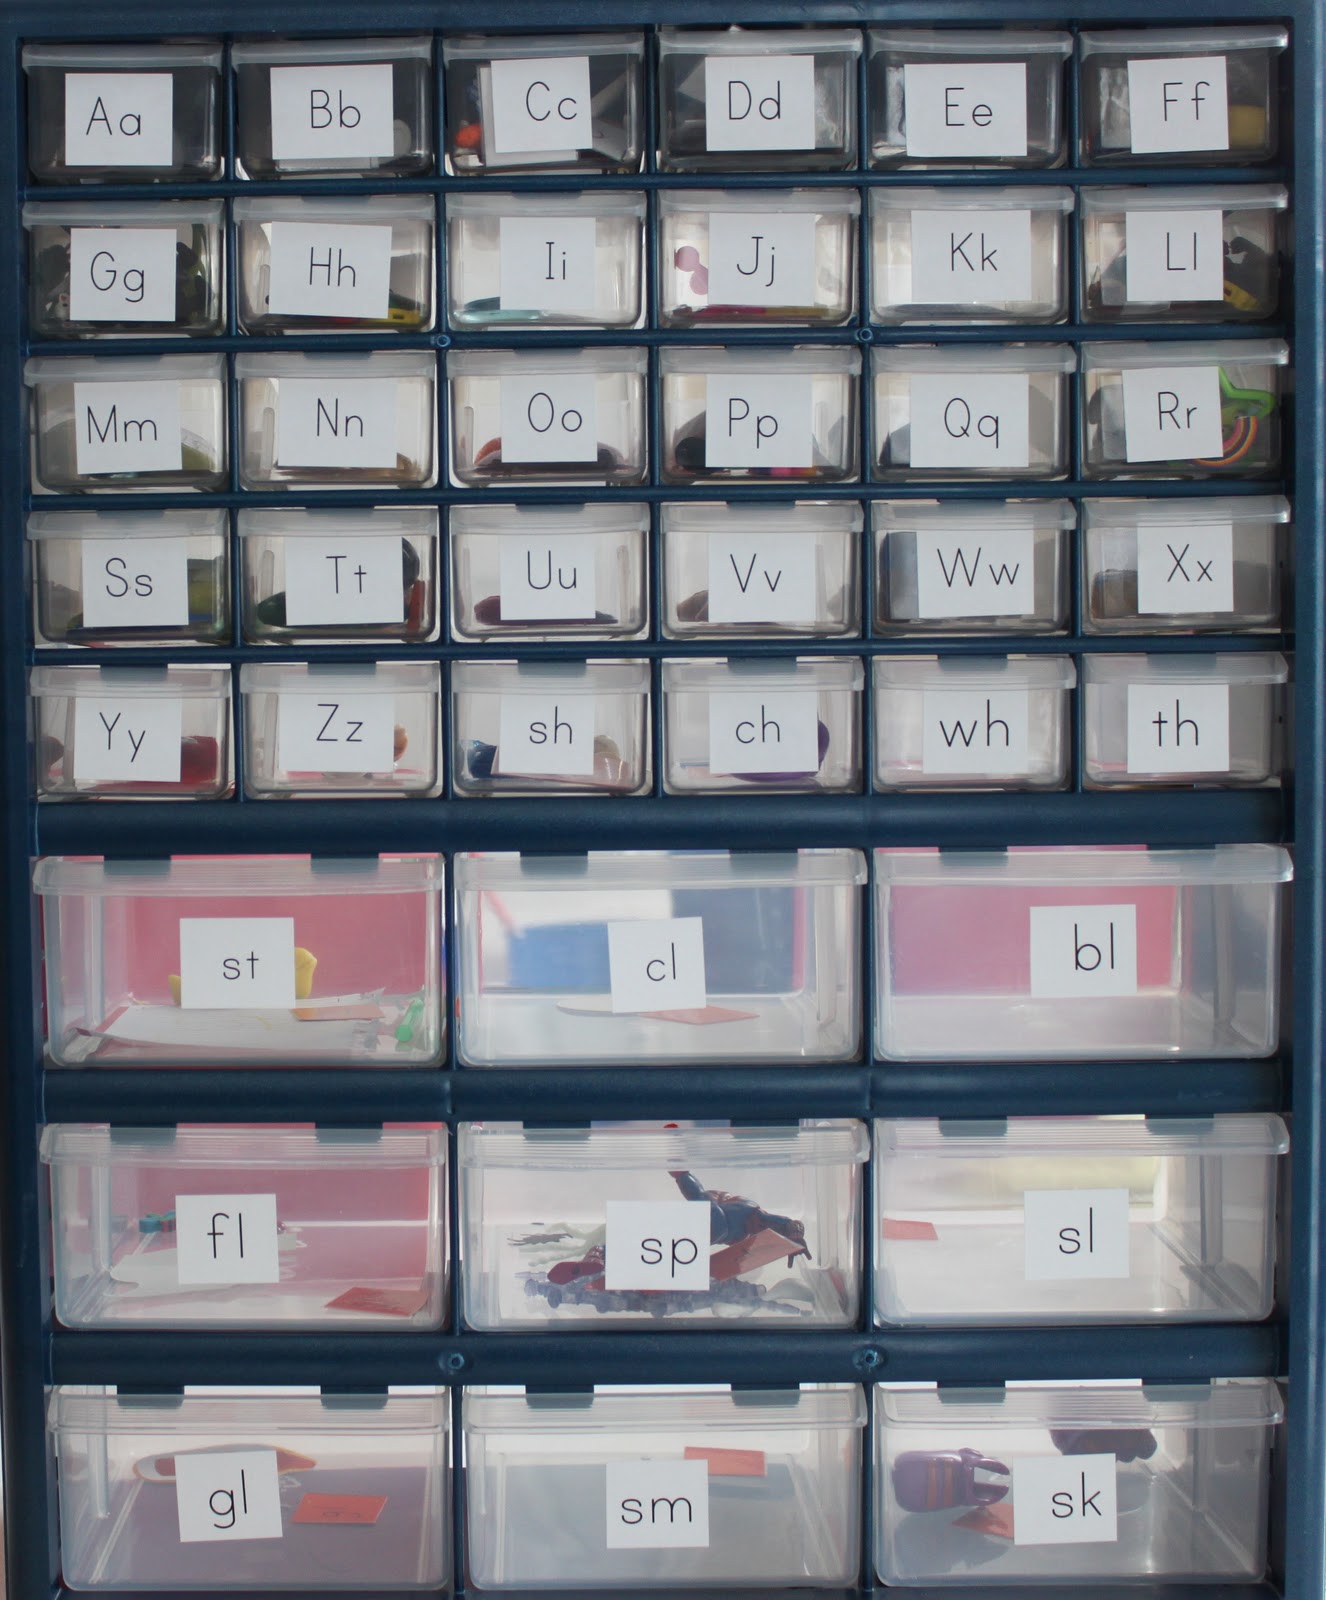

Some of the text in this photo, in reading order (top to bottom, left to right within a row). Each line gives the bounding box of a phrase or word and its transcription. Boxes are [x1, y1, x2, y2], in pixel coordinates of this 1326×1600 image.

[86, 96, 141, 136] Aa
[311, 90, 361, 128] Bb
[526, 81, 577, 121] Cc
[729, 80, 780, 120] Dd
[945, 87, 992, 126] Ee
[1163, 81, 1210, 121] Ff
[310, 247, 356, 287] Hh
[546, 242, 566, 280] Ii
[737, 236, 775, 287] Jj
[951, 232, 997, 271] Kk
[1167, 232, 1196, 270] Ll
[91, 251, 144, 303] Gg
[87, 404, 157, 444] Mm
[317, 398, 363, 437] Nn
[528, 392, 582, 432] Oo
[729, 398, 778, 449] Pp
[944, 398, 999, 449] Qq
[1158, 391, 1197, 430] Rr
[106, 557, 152, 597] Ss
[326, 556, 367, 594] Tt
[528, 550, 576, 590] Uu
[730, 553, 781, 593] Vv
[937, 547, 1019, 587] Ww
[1167, 544, 1212, 582] Xx
[99, 712, 145, 763] Yy
[316, 704, 363, 742] Zz
[529, 706, 572, 744] sh
[736, 705, 780, 744] ch
[939, 699, 1009, 747] wh
[1152, 699, 1198, 747] th
[223, 951, 259, 980] st
[646, 942, 676, 981] cl
[1074, 922, 1116, 971] bl
[207, 1213, 243, 1257] fl
[1059, 1207, 1093, 1254] sl
[641, 1238, 698, 1278] sp
[209, 1469, 247, 1529] gl
[621, 1497, 692, 1524] sm
[1052, 1471, 1102, 1518] sk
